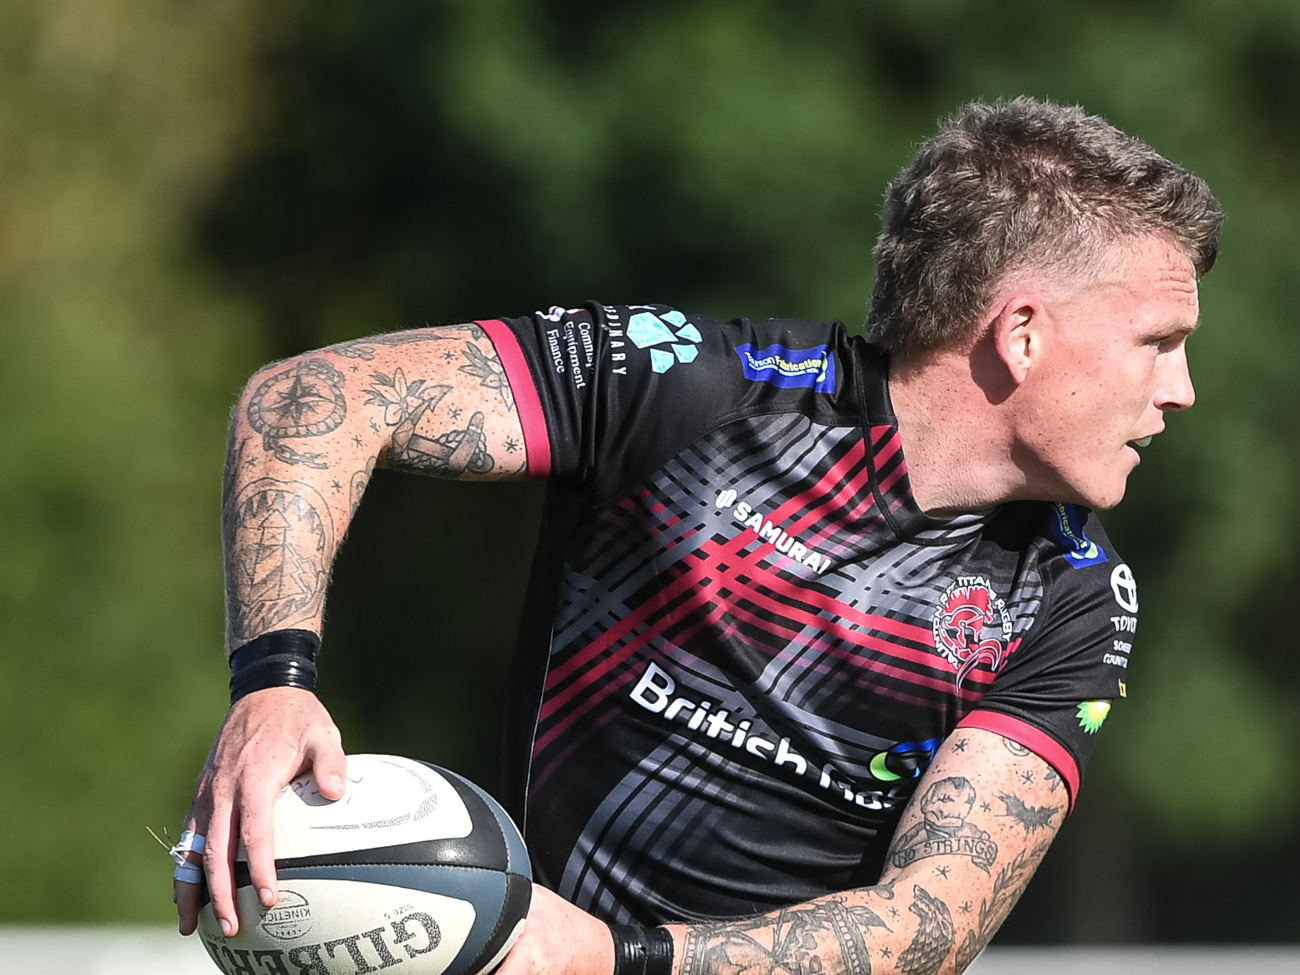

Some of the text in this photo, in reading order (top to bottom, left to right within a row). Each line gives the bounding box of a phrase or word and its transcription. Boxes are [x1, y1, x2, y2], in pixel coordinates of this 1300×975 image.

[546, 328, 566, 374] Finance
[733, 501, 832, 575] SAMURAI
[995, 598, 1013, 642] RUGBY
[924, 839, 994, 861] STRINGS
[259, 907, 312, 922] KINETICA
